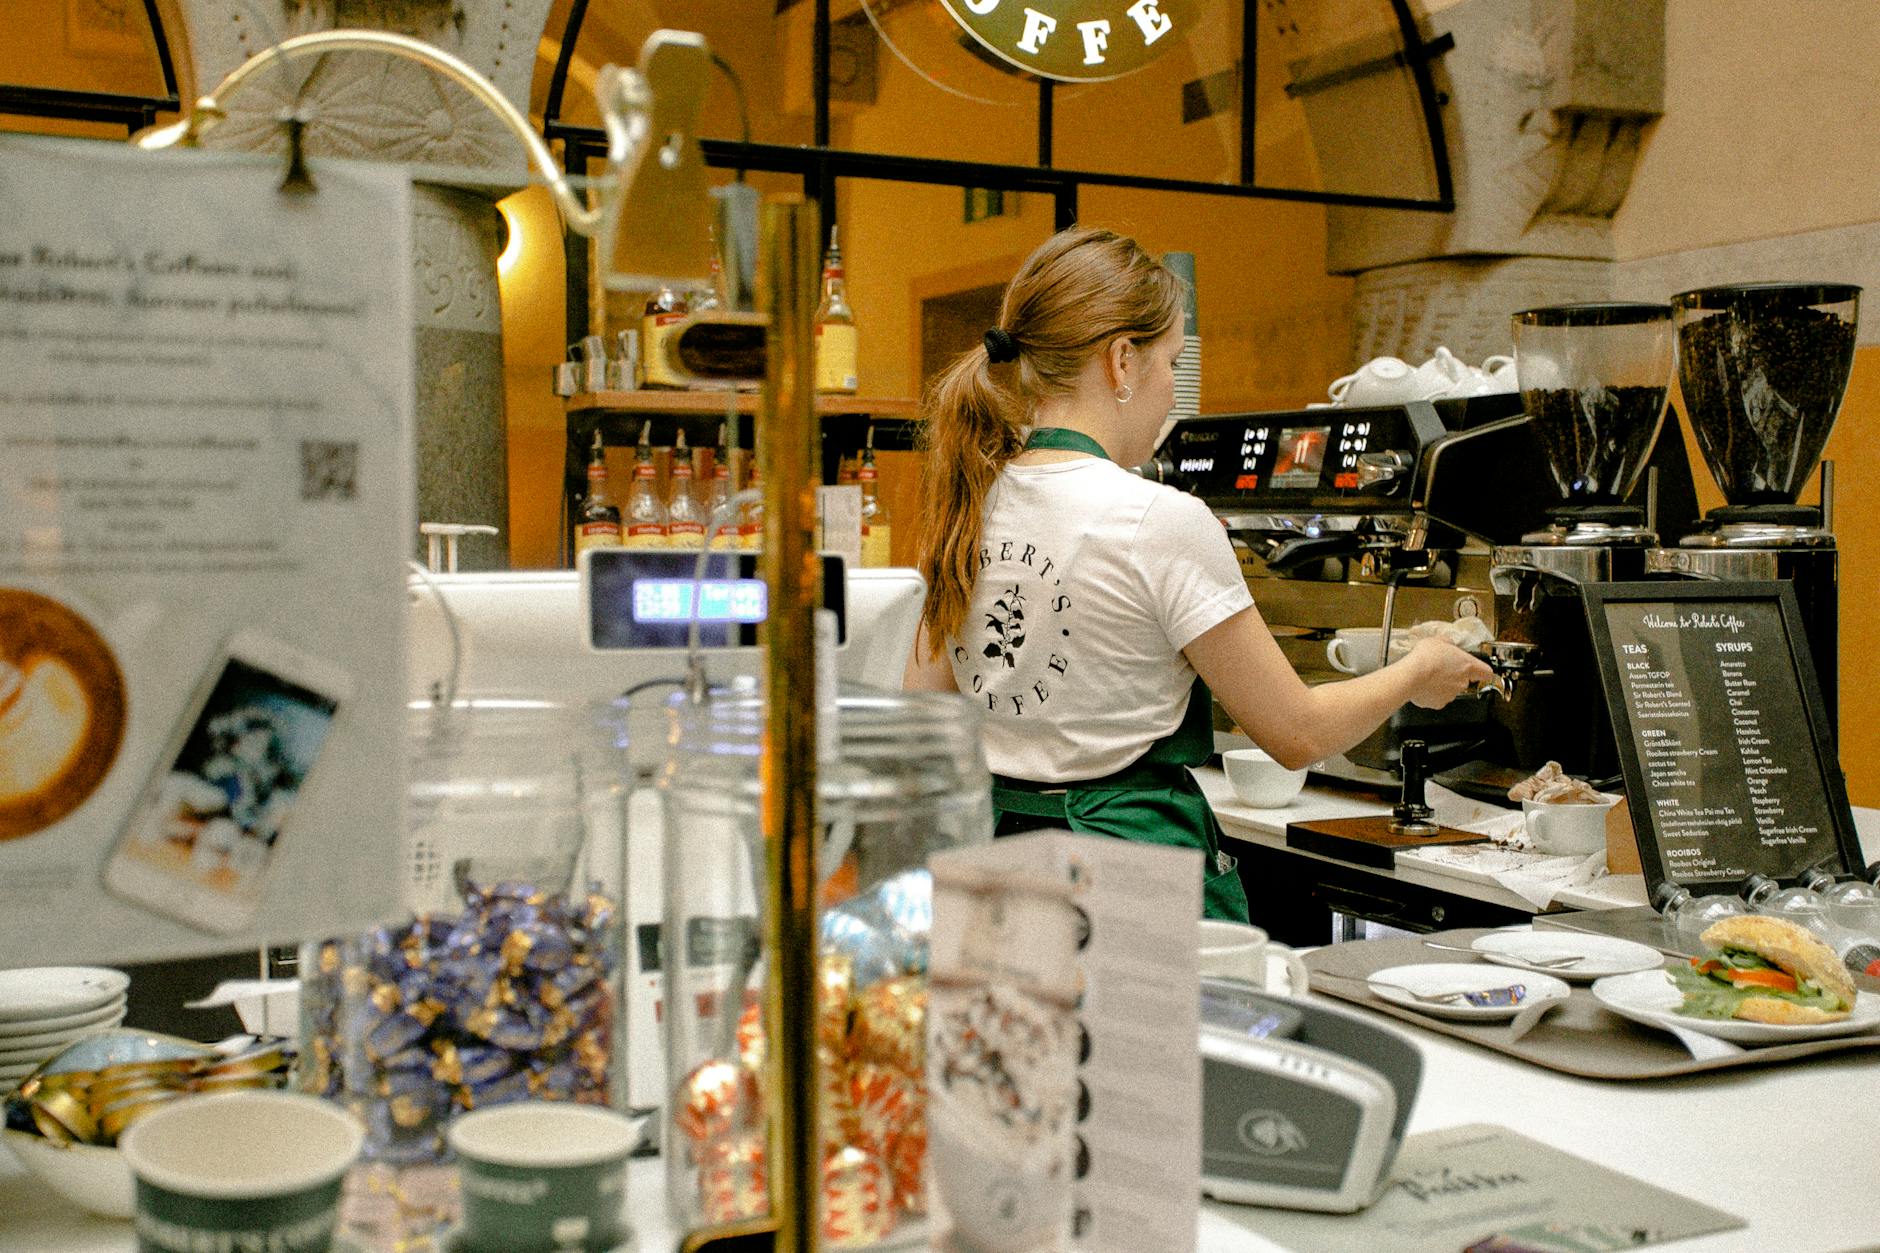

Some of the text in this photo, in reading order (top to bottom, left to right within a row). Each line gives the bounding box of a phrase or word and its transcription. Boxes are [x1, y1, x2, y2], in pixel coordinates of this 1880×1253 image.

[979, 541, 1072, 613] BERT'S
[1643, 614, 1678, 628] Welcome
[1680, 616, 1691, 628] to
[1720, 614, 1745, 633] Coffee
[1622, 644, 1648, 654] TEAS
[1716, 643, 1753, 652] SYRUPS
[1627, 662, 1650, 670] BLACK
[954, 653, 1069, 716] COFFEE
[1646, 748, 1718, 758] Rooibos strawberry Cream
[1740, 748, 1759, 756] Kahlua
[1650, 769, 1686, 779] Japan sencha
[1747, 777, 1768, 786] Orange
[1752, 797, 1780, 806] Raspberry
[1704, 808, 1714, 816] Pai
[1724, 807, 1735, 815] Tan
[1754, 807, 1784, 815] Strawberry
[1663, 830, 1681, 838] Sweet
[1759, 827, 1785, 836] Sugarfree
[1785, 826, 1798, 834] Irish
[1761, 837, 1787, 846] Sugarfree
[1666, 848, 1701, 857] ROOIBOS
[1693, 858, 1716, 868] Original
[1672, 870, 1694, 878] Rooibos
[1694, 869, 1726, 877] Strawberry
